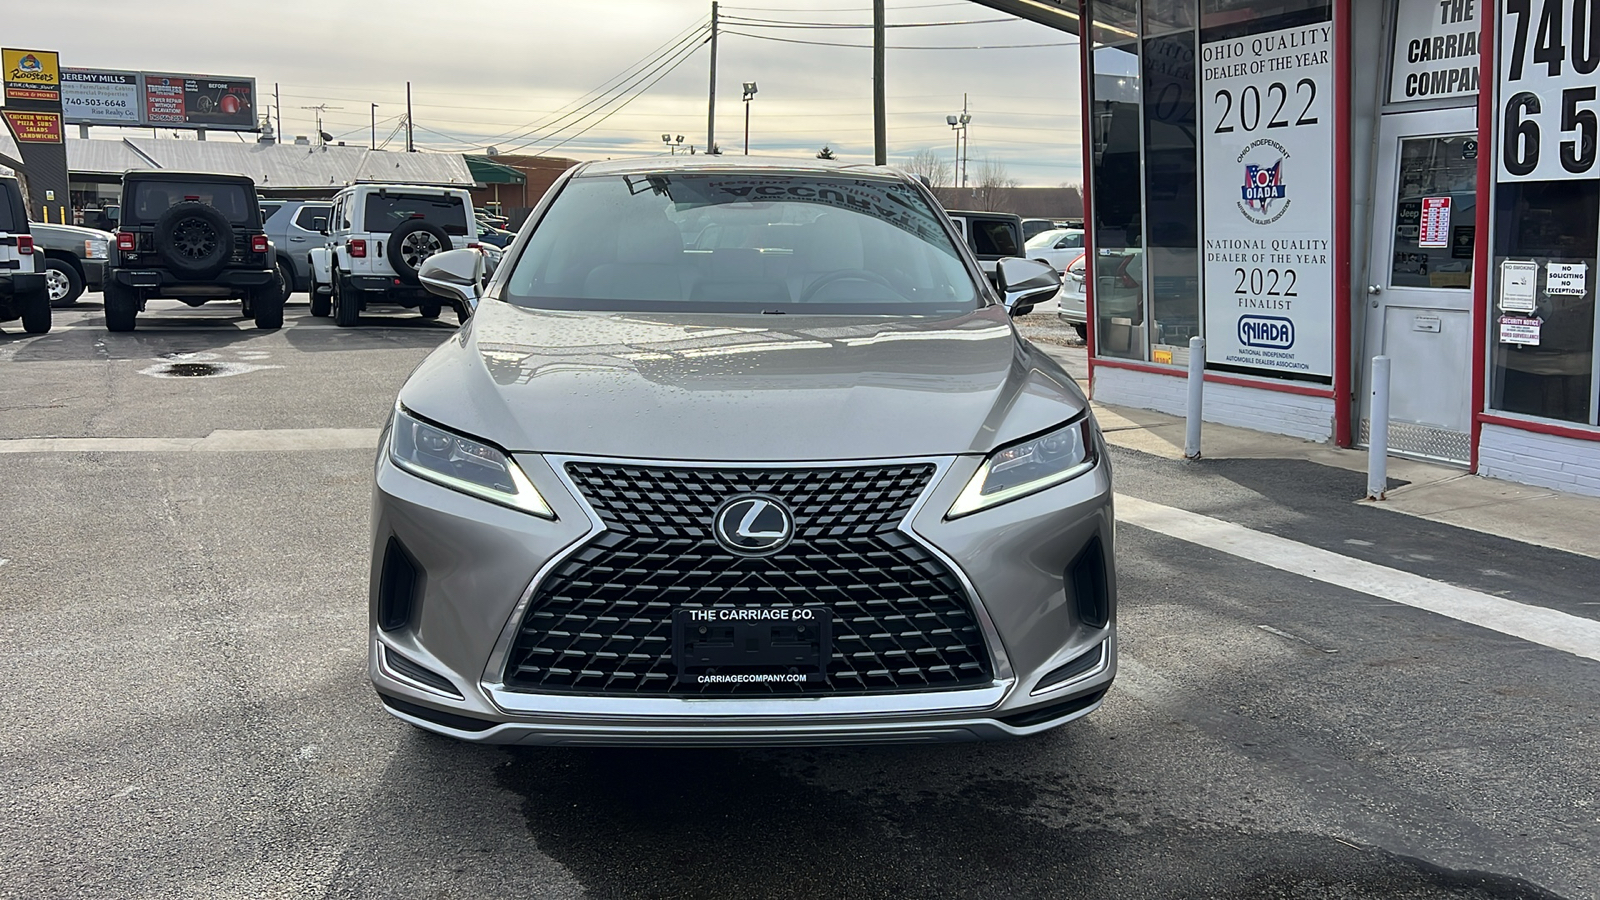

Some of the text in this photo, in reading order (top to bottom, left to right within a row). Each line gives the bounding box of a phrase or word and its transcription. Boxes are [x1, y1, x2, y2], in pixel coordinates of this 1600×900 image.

[1441, 1, 1474, 24] THE
[1203, 26, 1331, 62] OHIO QUALITY
[1408, 31, 1482, 63] CARRIA
[1507, 0, 1600, 81] 740
[1205, 50, 1329, 81] DEALER OF THE YEAR
[10, 68, 54, 82] Roosters
[62, 73, 126, 83] JEREMY MILLS
[65, 97, 127, 108] 740-503-6648
[1214, 78, 1318, 134] 2022
[105, 109, 124, 118] Realty
[19, 132, 59, 140] SANDWICHES
[1237, 138, 1291, 163] OHIO INDEPENDENT
[1246, 186, 1278, 199] OIADA
[1400, 208, 1420, 219] Jeep
[1206, 239, 1328, 251] NATIONAL QUALITY
[1208, 252, 1327, 265] DEALER OF THE YEAR
[1234, 267, 1298, 297] 2022
[1547, 287, 1584, 295] EXCEPTIONS
[1238, 297, 1292, 310] FINALIST
[1242, 321, 1289, 343] NIADA
[1238, 348, 1295, 360] NATIONAL INDEPENDENT
[1226, 355, 1310, 370] AUTOMOBILE DEALERS ASSOCIATION
[690, 609, 815, 621] THE CARRIAGE CO.
[697, 674, 807, 683] CARRIAGECOMPANY.COM
